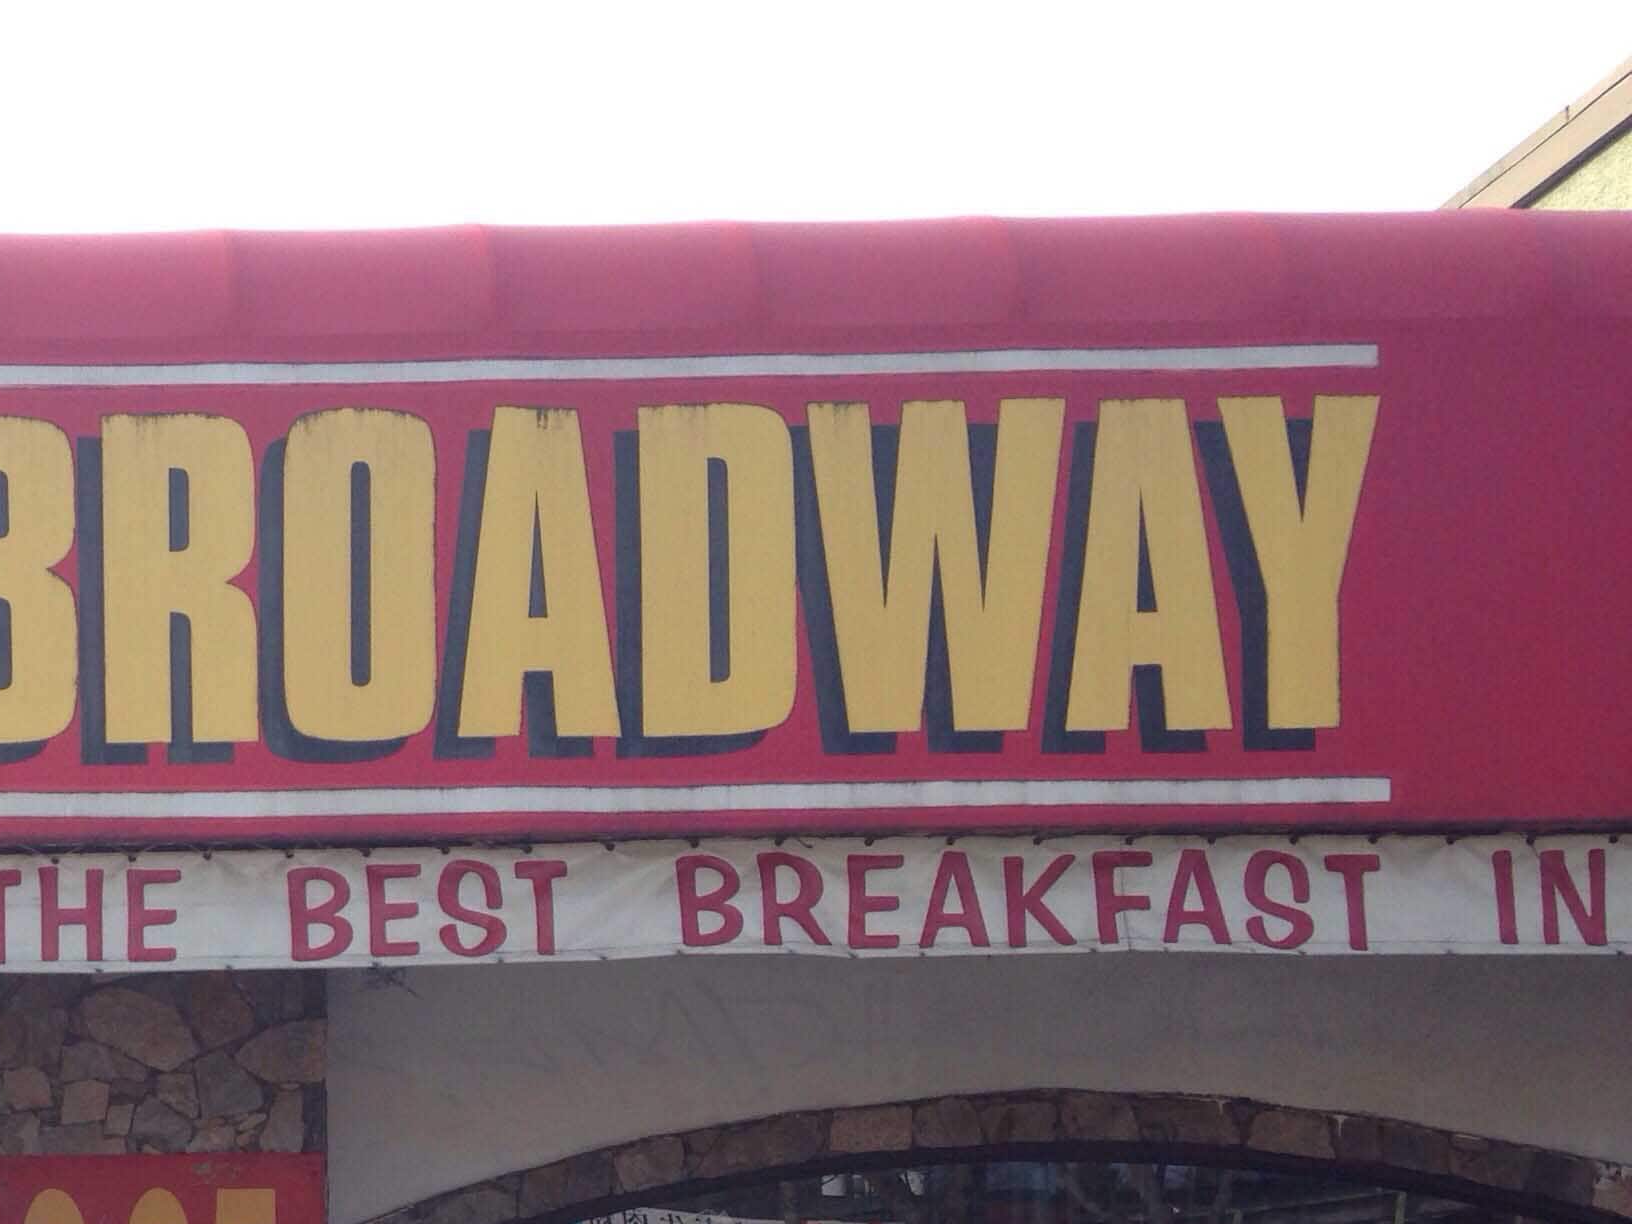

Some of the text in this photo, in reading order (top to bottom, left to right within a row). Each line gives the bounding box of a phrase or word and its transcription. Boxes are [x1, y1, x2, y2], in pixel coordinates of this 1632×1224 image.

[287, 859, 568, 962] BEST
[676, 849, 1381, 951] BREAKFAST
[1492, 848, 1609, 947] IN
